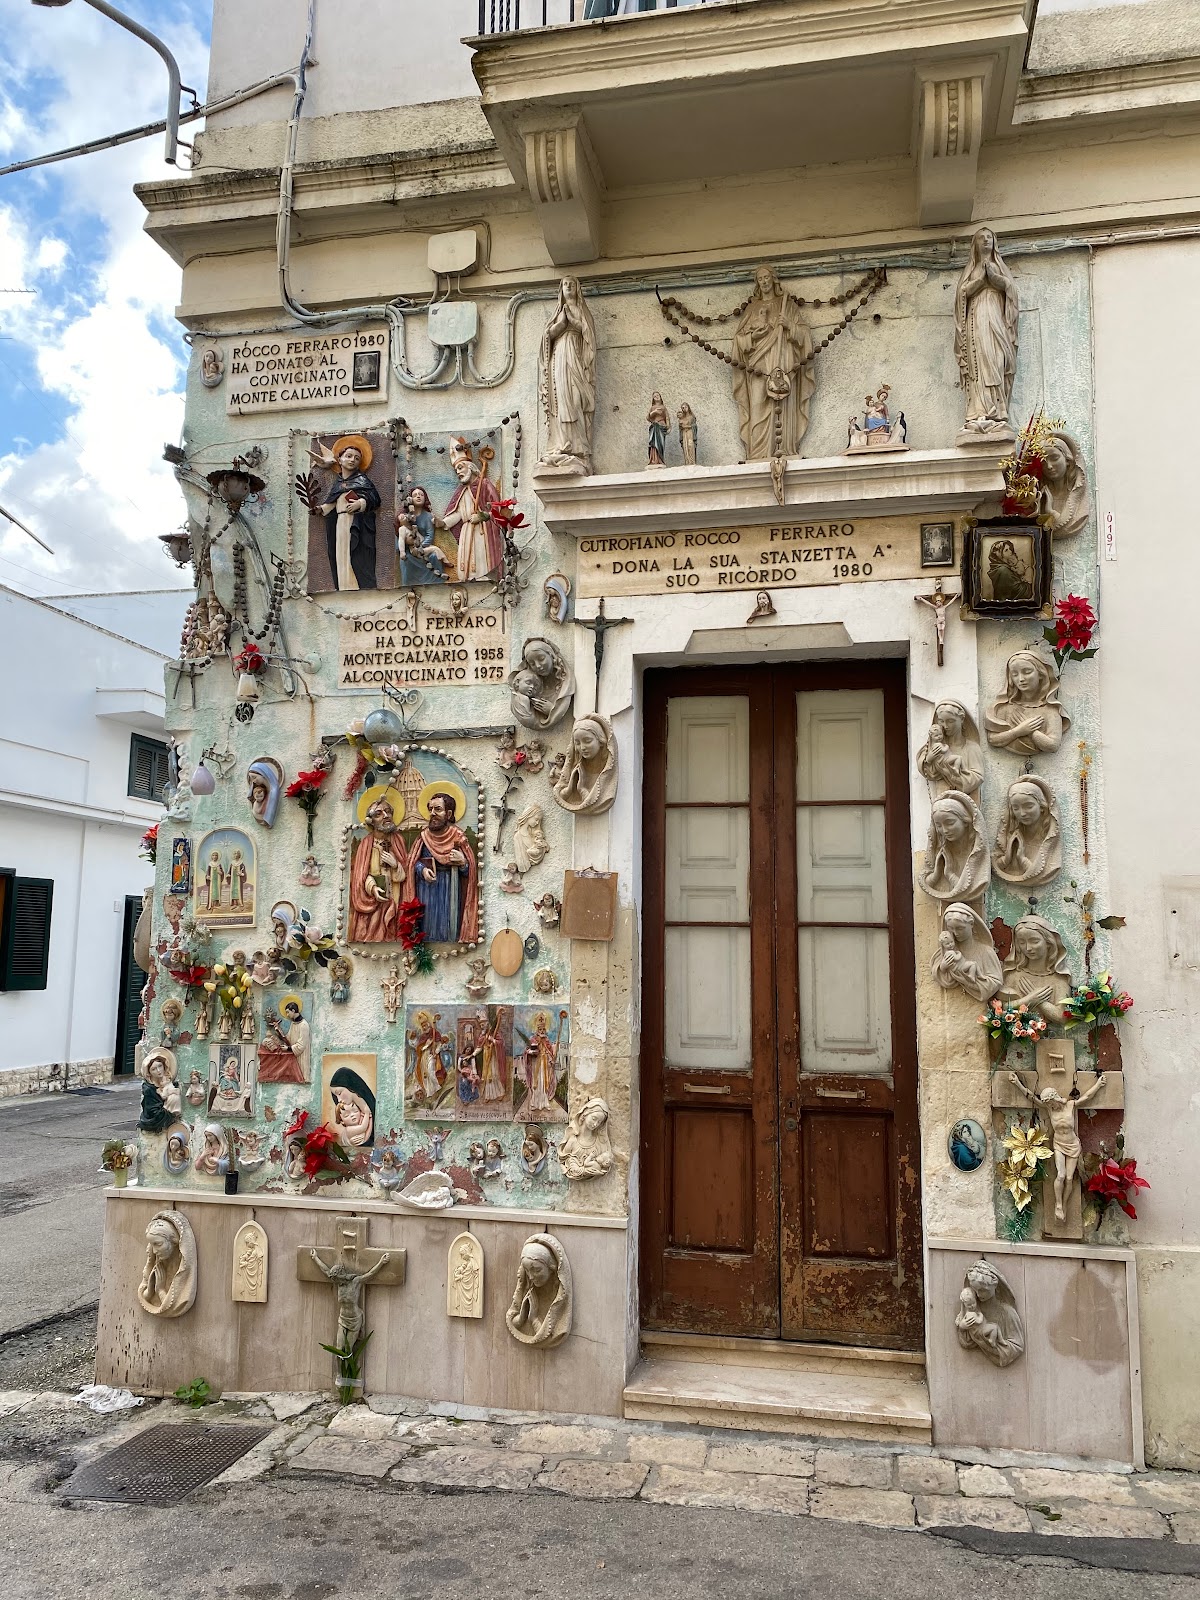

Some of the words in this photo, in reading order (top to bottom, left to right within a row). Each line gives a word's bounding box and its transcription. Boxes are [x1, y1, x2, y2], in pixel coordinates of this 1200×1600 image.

[233, 344, 280, 359] ROCCO
[286, 337, 351, 354] FERRARO
[354, 334, 385, 347] 1980
[231, 362, 249, 374] HA
[255, 356, 313, 372] DONATO
[319, 353, 338, 366] AL
[250, 368, 347, 387] CONVICINATO
[230, 390, 277, 406] MONTE
[280, 384, 350, 401] CALVARIO
[580, 535, 676, 553] CUTROFIANO
[684, 531, 741, 547] ROCCO
[769, 523, 855, 542] FERRARO
[612, 559, 660, 574] DONA
[673, 557, 694, 571] LA
[709, 554, 740, 568] SUA
[760, 546, 857, 565] STANZETTA
[666, 573, 700, 588] SUO
[718, 567, 797, 585] RICORDO
[832, 562, 873, 578] 1980
[353, 618, 408, 633] ROCCO
[425, 615, 497, 630] FERRARO
[375, 636, 395, 649] HA
[401, 633, 465, 648] DONATO
[474, 647, 504, 661] 1958
[474, 666, 504, 679] 1975
